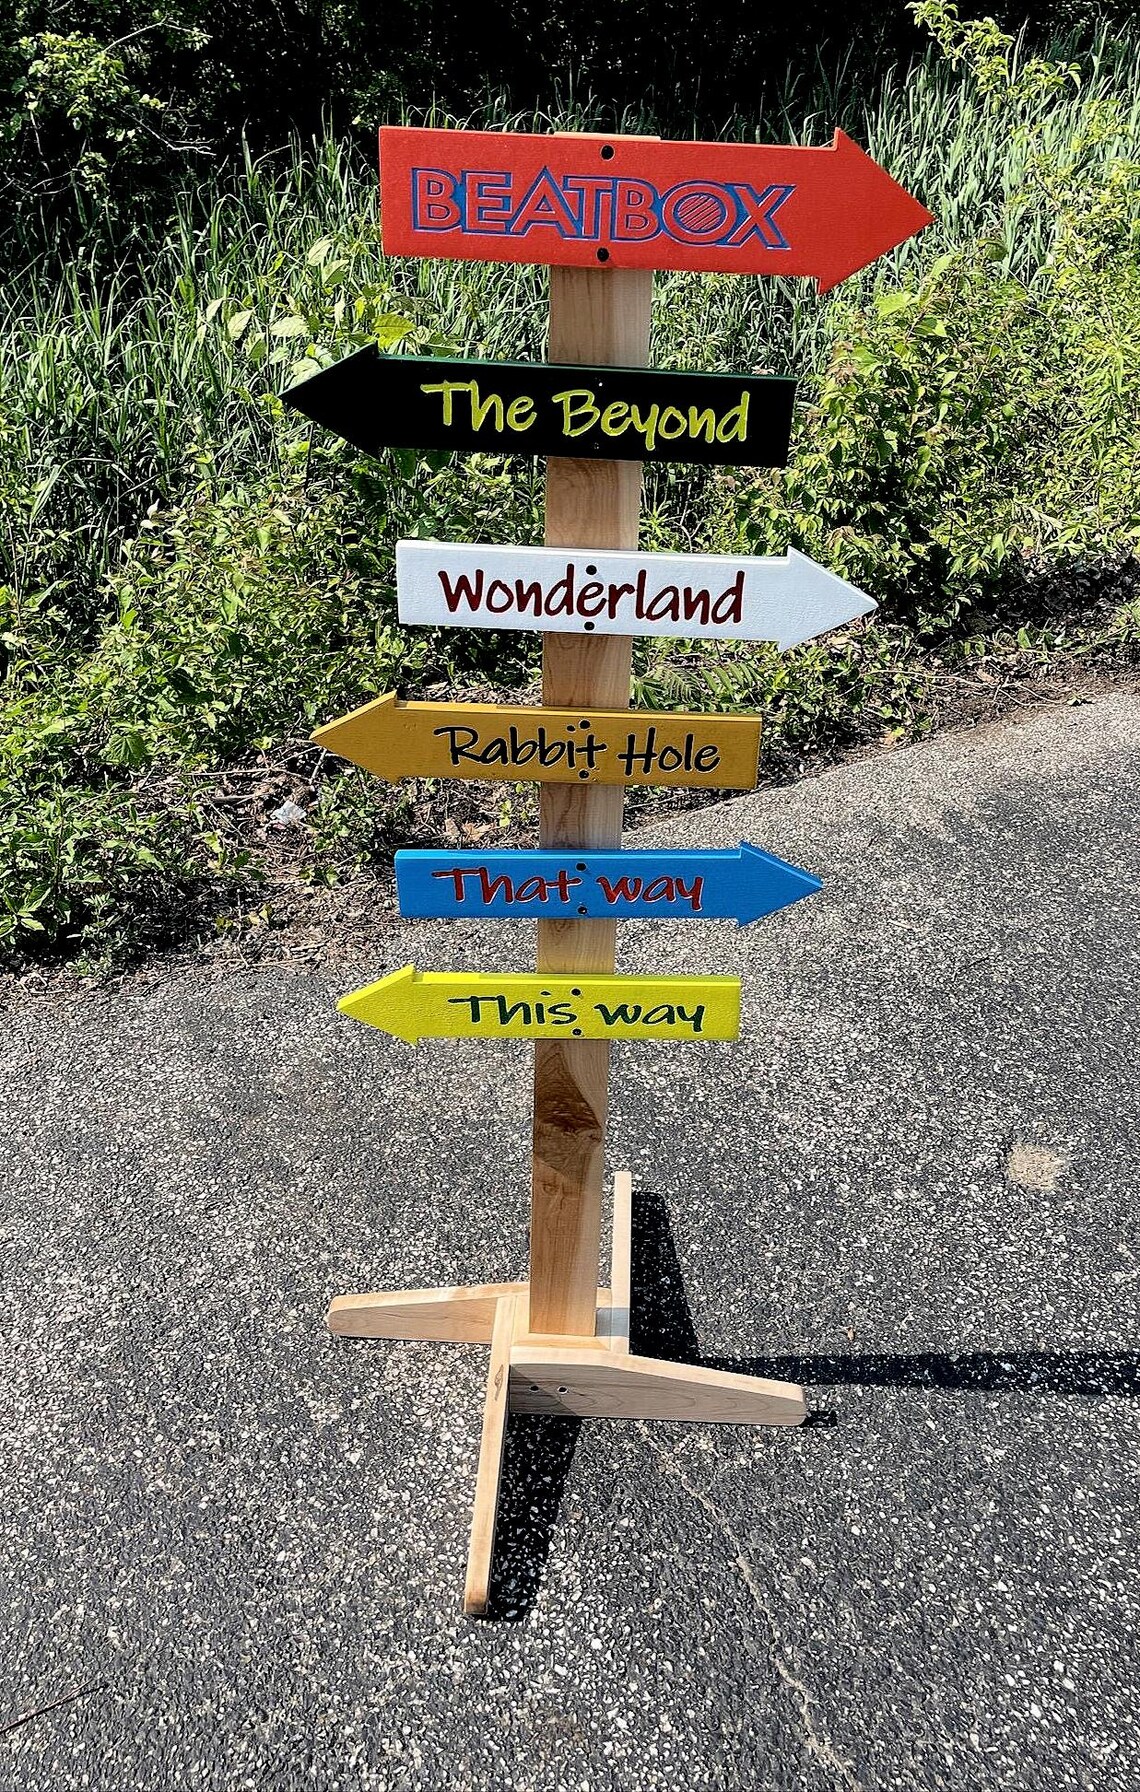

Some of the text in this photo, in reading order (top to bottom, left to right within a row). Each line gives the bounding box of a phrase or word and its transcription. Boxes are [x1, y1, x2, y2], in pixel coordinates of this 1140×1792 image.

[411, 166, 796, 250] BEATBOX
[420, 379, 751, 450] The Beyond
[438, 563, 746, 624] Wonderland
[434, 724, 721, 773] Rabbit Hole
[431, 866, 704, 911] That way
[448, 990, 706, 1033] This way
